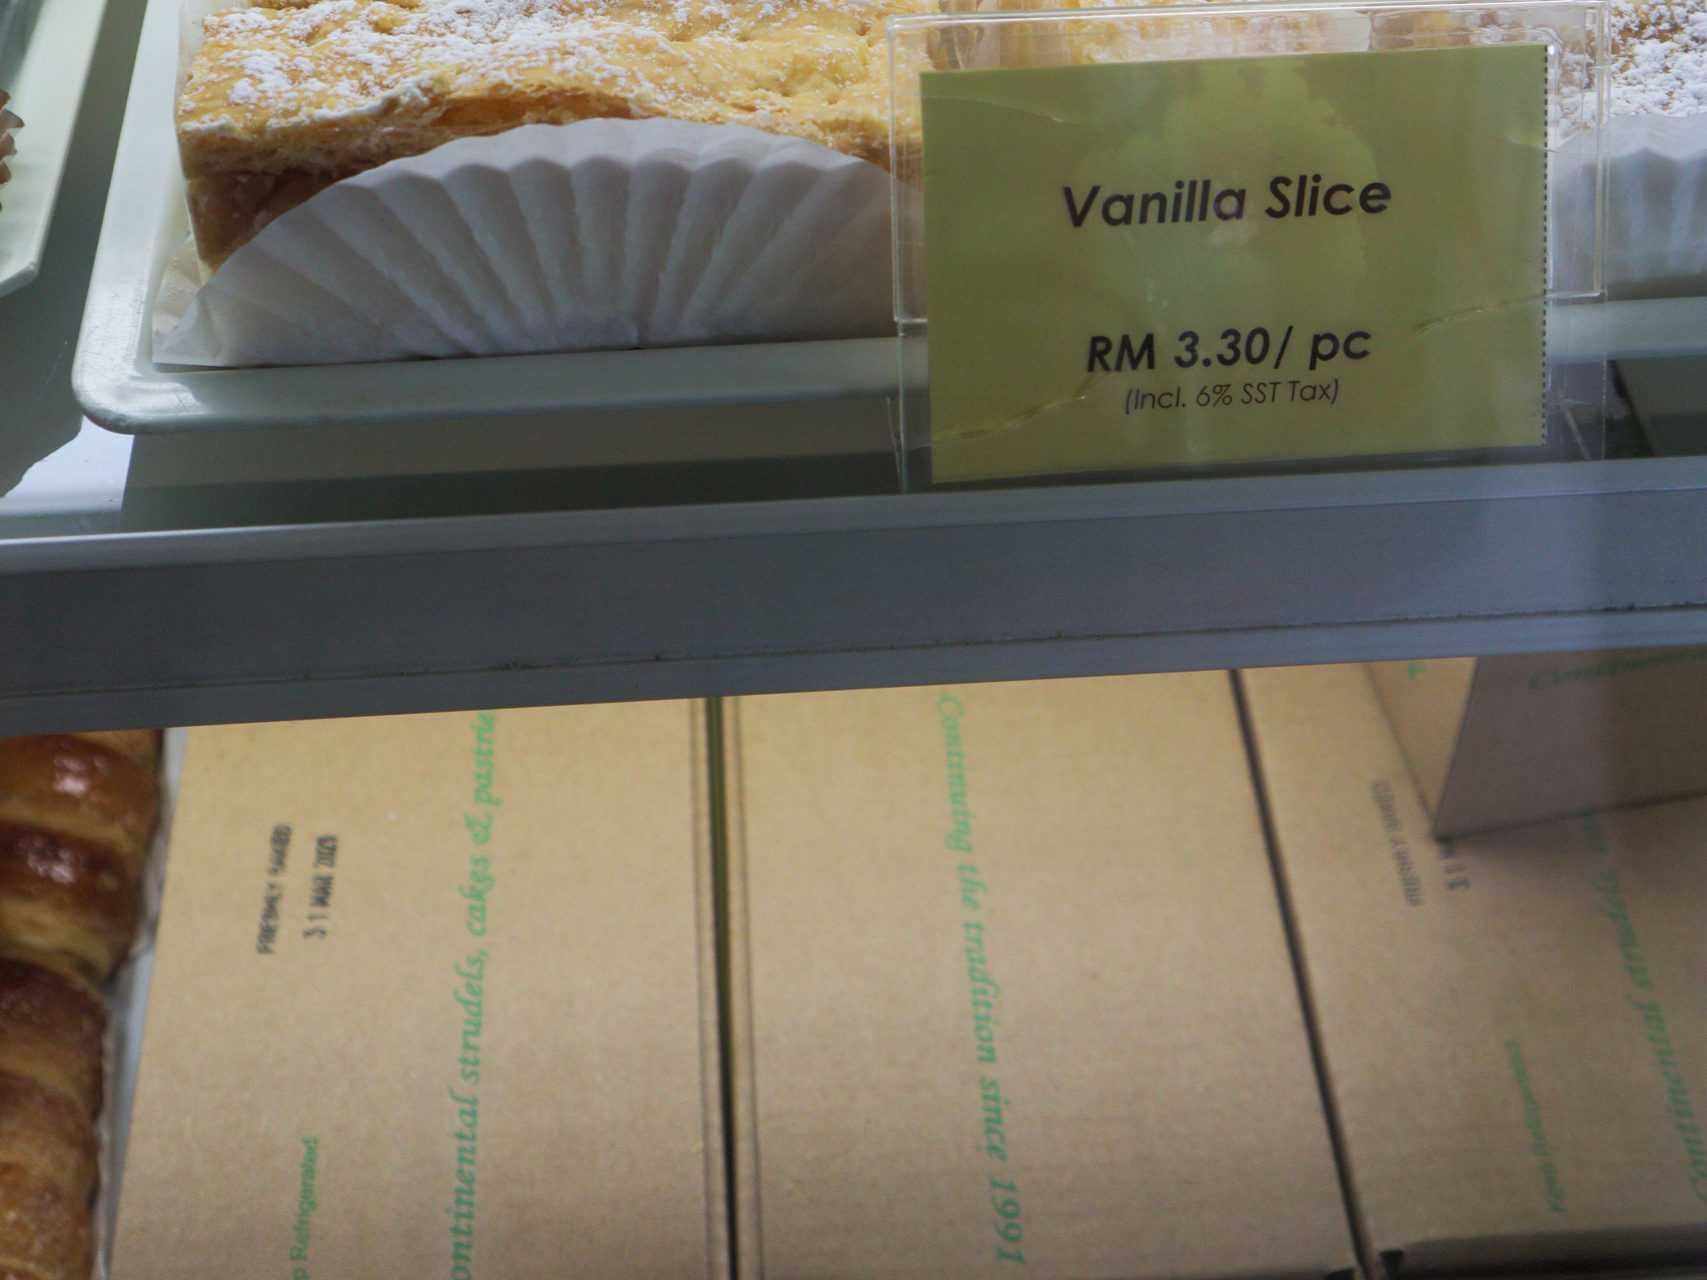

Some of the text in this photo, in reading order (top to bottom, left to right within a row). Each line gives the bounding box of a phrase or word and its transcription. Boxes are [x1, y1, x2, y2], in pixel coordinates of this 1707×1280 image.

[1062, 173, 1393, 228] Vanilla Slice
[1087, 325, 1373, 373] RM 3.30/ pc
[1125, 378, 1340, 415] (Incl. 6% SST Tax)
[470, 709, 502, 807] pastrie
[457, 855, 496, 937] cakes
[452, 949, 490, 1085] strudels,
[936, 695, 1025, 1264] Continuing the tradition since 1991
[289, 1136, 321, 1260] Refrigerated
[445, 1086, 480, 1280] ontinental
